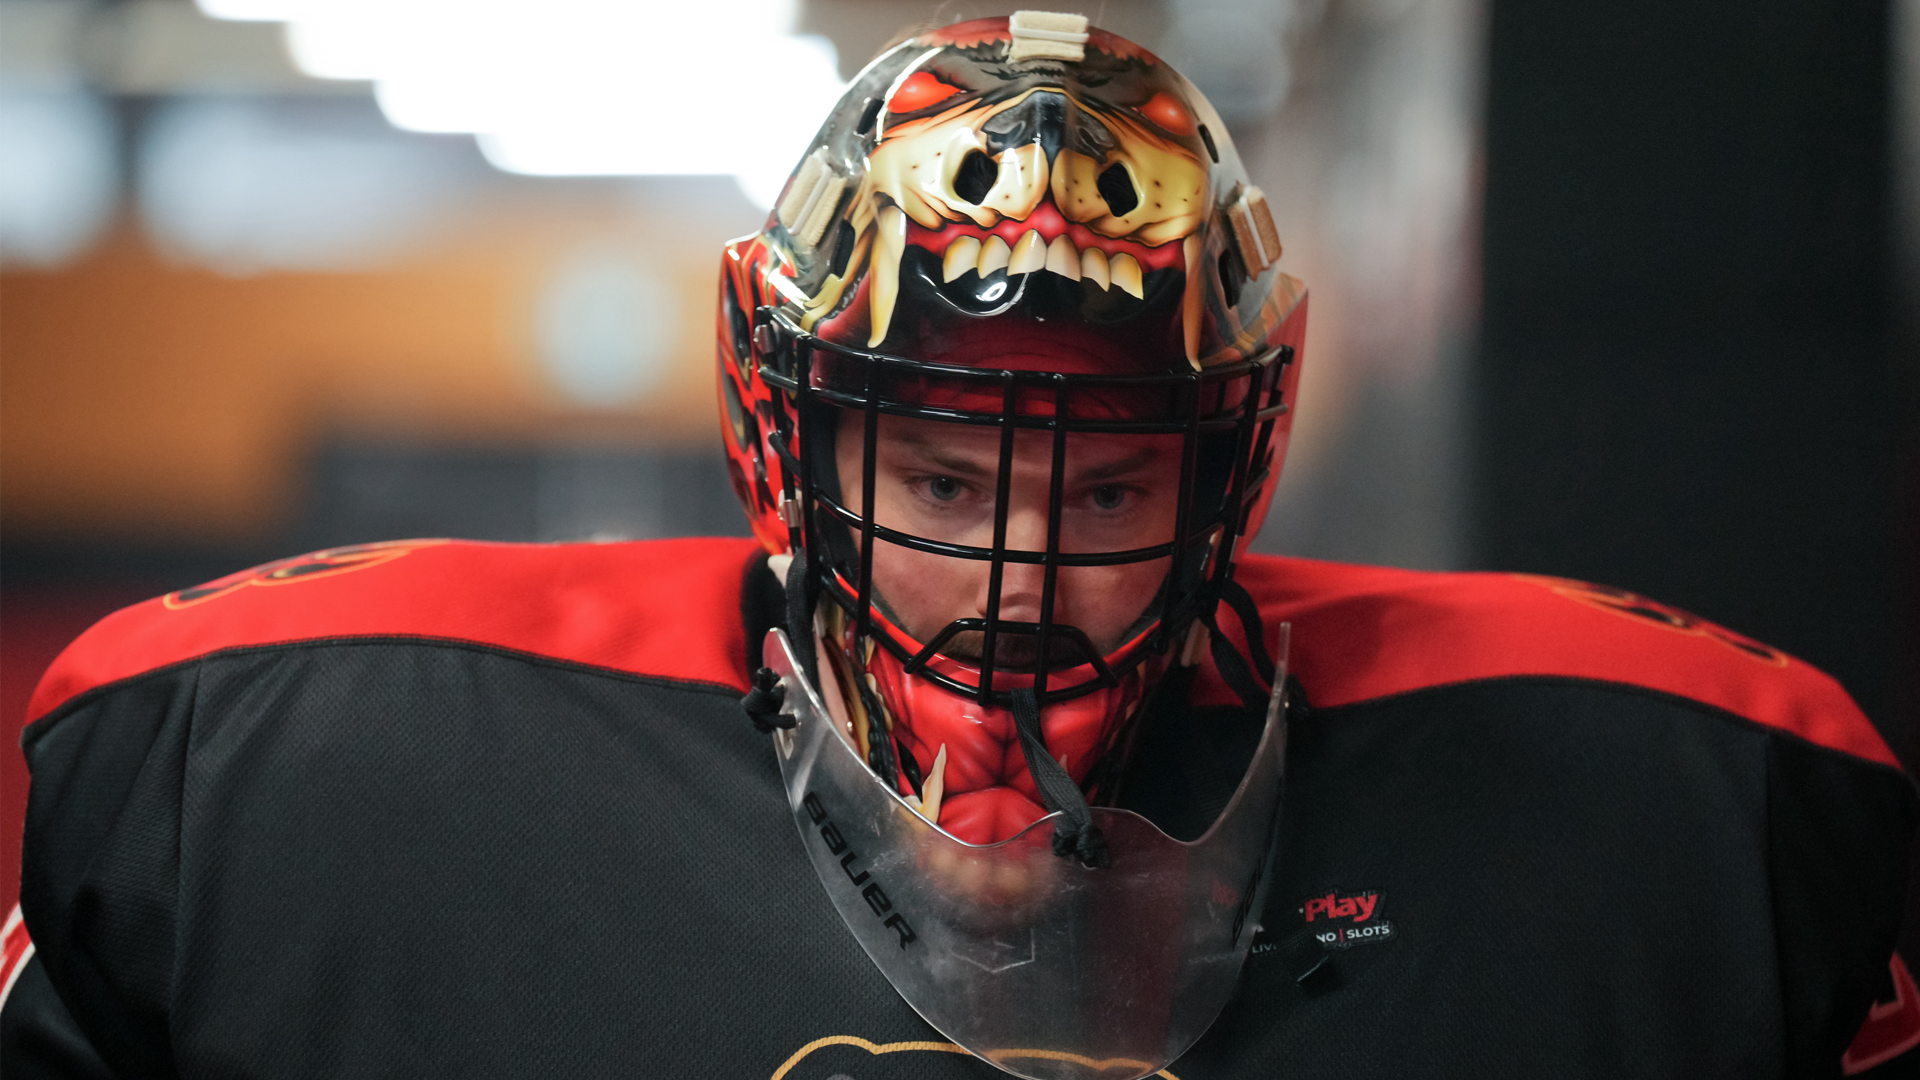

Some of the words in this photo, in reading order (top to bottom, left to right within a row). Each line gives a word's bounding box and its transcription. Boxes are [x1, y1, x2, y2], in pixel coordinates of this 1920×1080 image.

[803, 791, 917, 951] BAUER
[1304, 893, 1378, 922] Play
[1346, 925, 1390, 939] SLOTS
